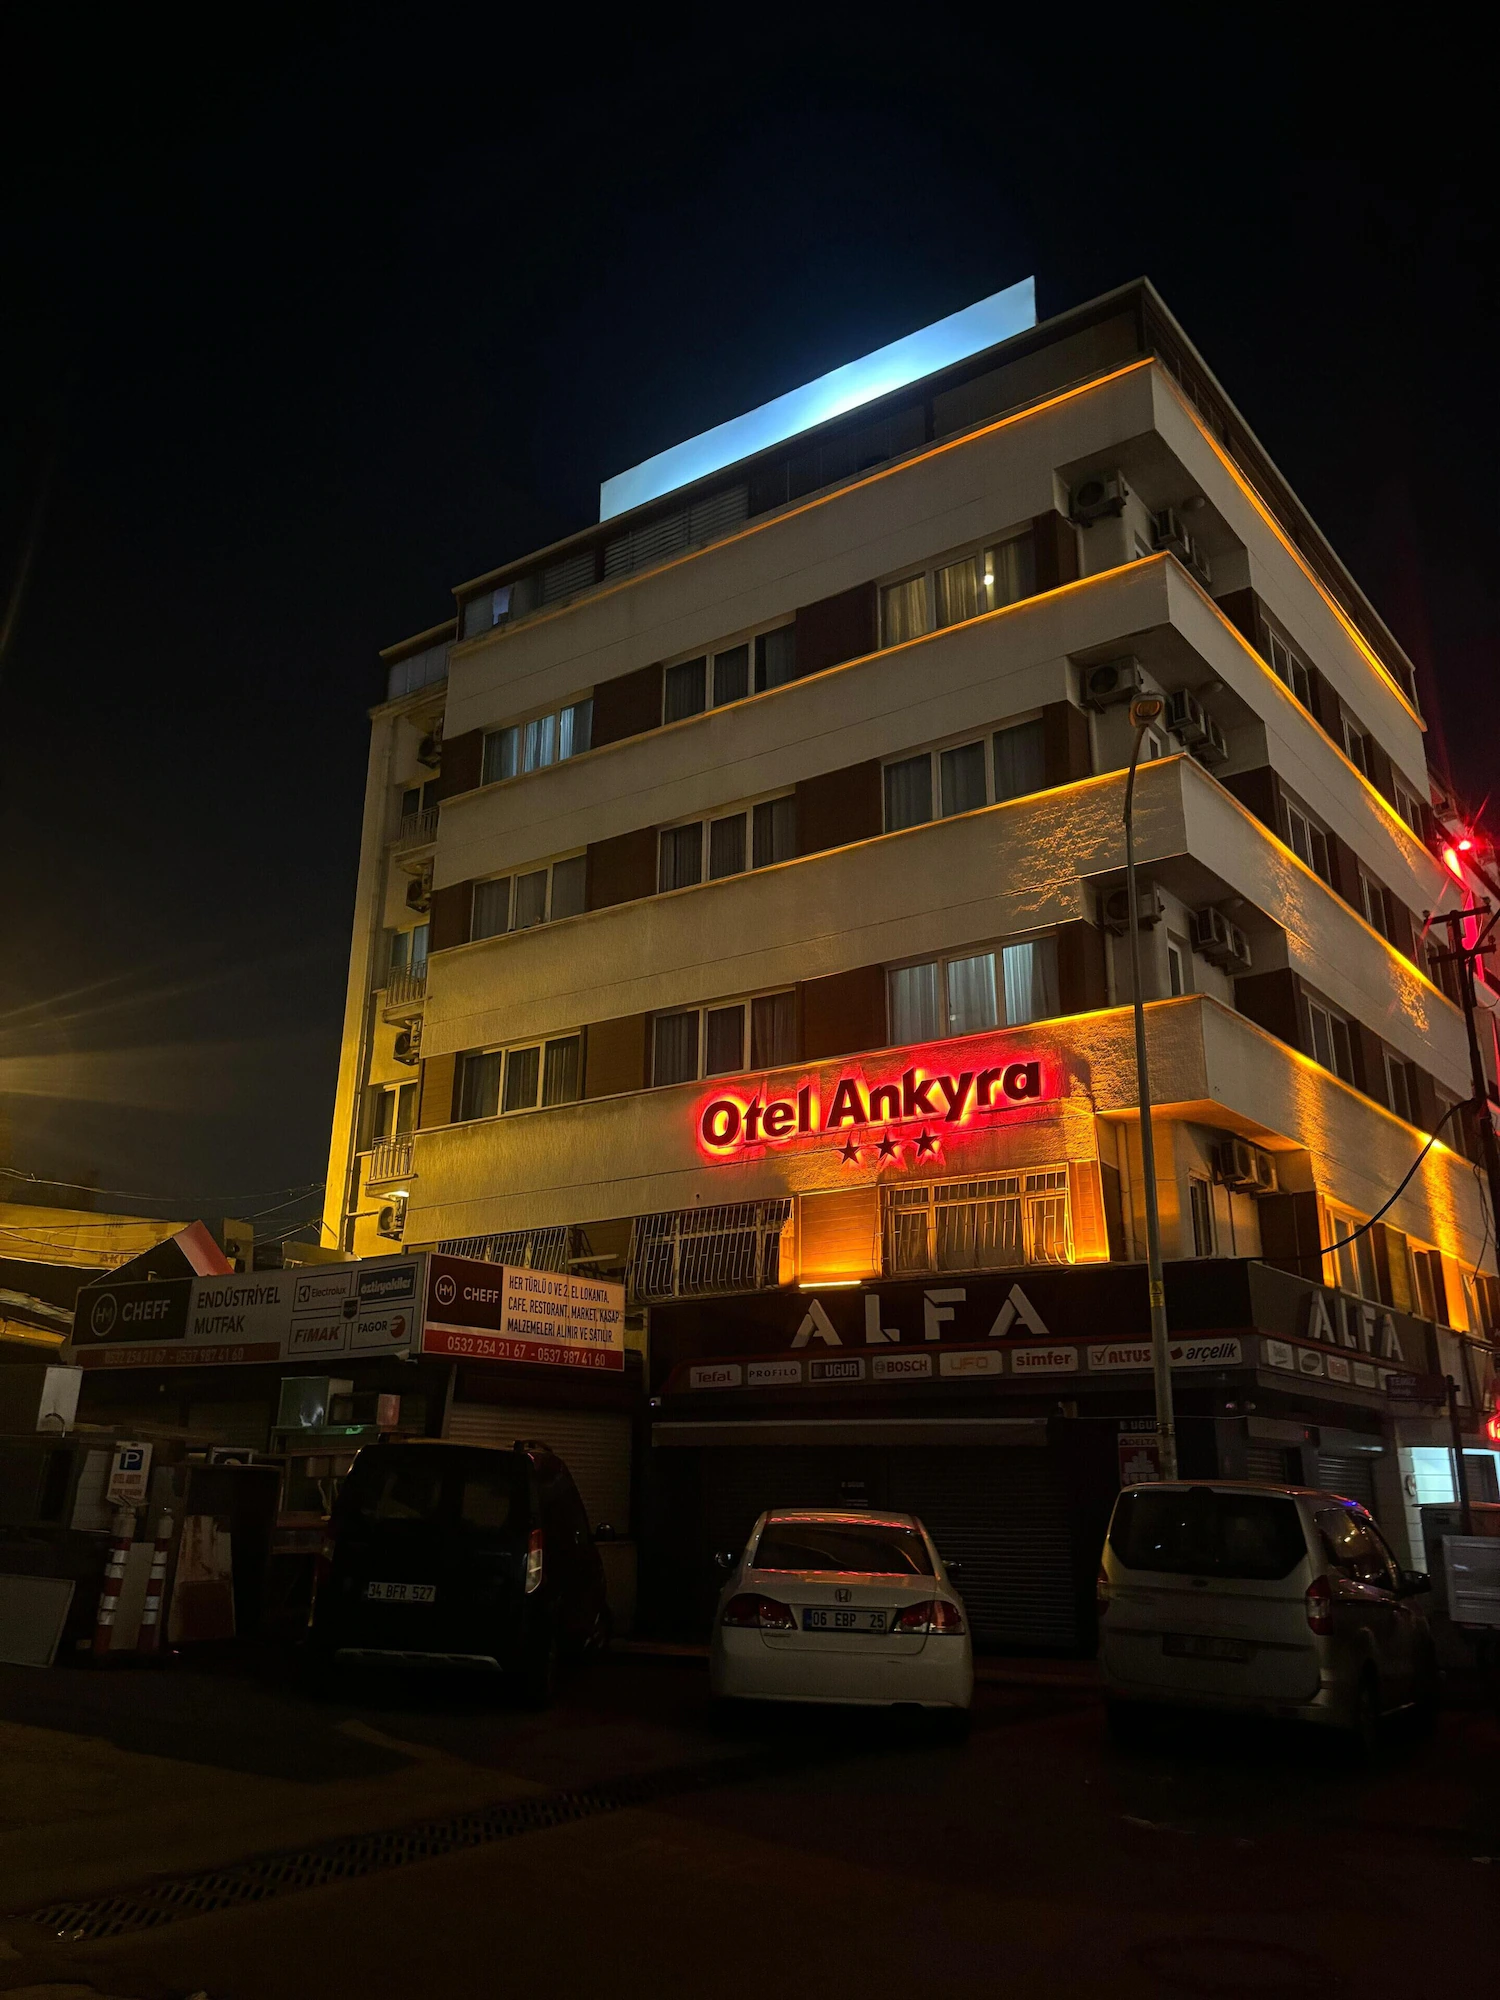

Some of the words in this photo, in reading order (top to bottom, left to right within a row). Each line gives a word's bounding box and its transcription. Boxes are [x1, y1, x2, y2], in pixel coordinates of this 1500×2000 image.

[702, 1085, 811, 1147] Otel
[827, 1061, 1040, 1123] Ankyra
[311, 1286, 346, 1298] Electrolux
[463, 1287, 500, 1304] CHEFF
[509, 1275, 523, 1291] HER
[525, 1276, 547, 1294] TÜRLÜ
[554, 1282, 563, 1297] VE
[571, 1285, 579, 1299] EL
[197, 1284, 281, 1309] ENDÜSTRİYEL
[122, 1300, 171, 1322] CHEFF
[599, 1309, 620, 1324] KASAP
[790, 1283, 1050, 1348] ALFA
[194, 1315, 246, 1334] MUTFAK
[357, 1320, 388, 1333] FAGOR
[507, 1317, 555, 1337] MALZEMELERİ
[556, 1324, 578, 1339] ALINIR
[579, 1326, 588, 1341] VE
[1307, 1289, 1405, 1362] ALFA
[447, 1336, 474, 1353] 0532
[476, 1339, 496, 1354] 254
[499, 1342, 510, 1356] 21
[514, 1343, 526, 1358] 67
[538, 1347, 561, 1363] 0537
[563, 1350, 580, 1364] 987
[581, 1351, 592, 1365] 41
[594, 1352, 606, 1366] 60
[1016, 1351, 1071, 1366] simfer
[1108, 1349, 1151, 1364] ALTUS
[1186, 1343, 1237, 1363] arçelik
[886, 1360, 928, 1373] BOSCH
[950, 1356, 988, 1370] UFO
[696, 1370, 732, 1383] Tefal
[1129, 1438, 1157, 1446] DELTA
[124, 1452, 141, 1468] P
[369, 1583, 381, 1597] 34
[413, 1586, 433, 1600] 527
[813, 1612, 827, 1626] 06
[835, 1613, 856, 1627] EBP
[870, 1614, 884, 1628] 25
